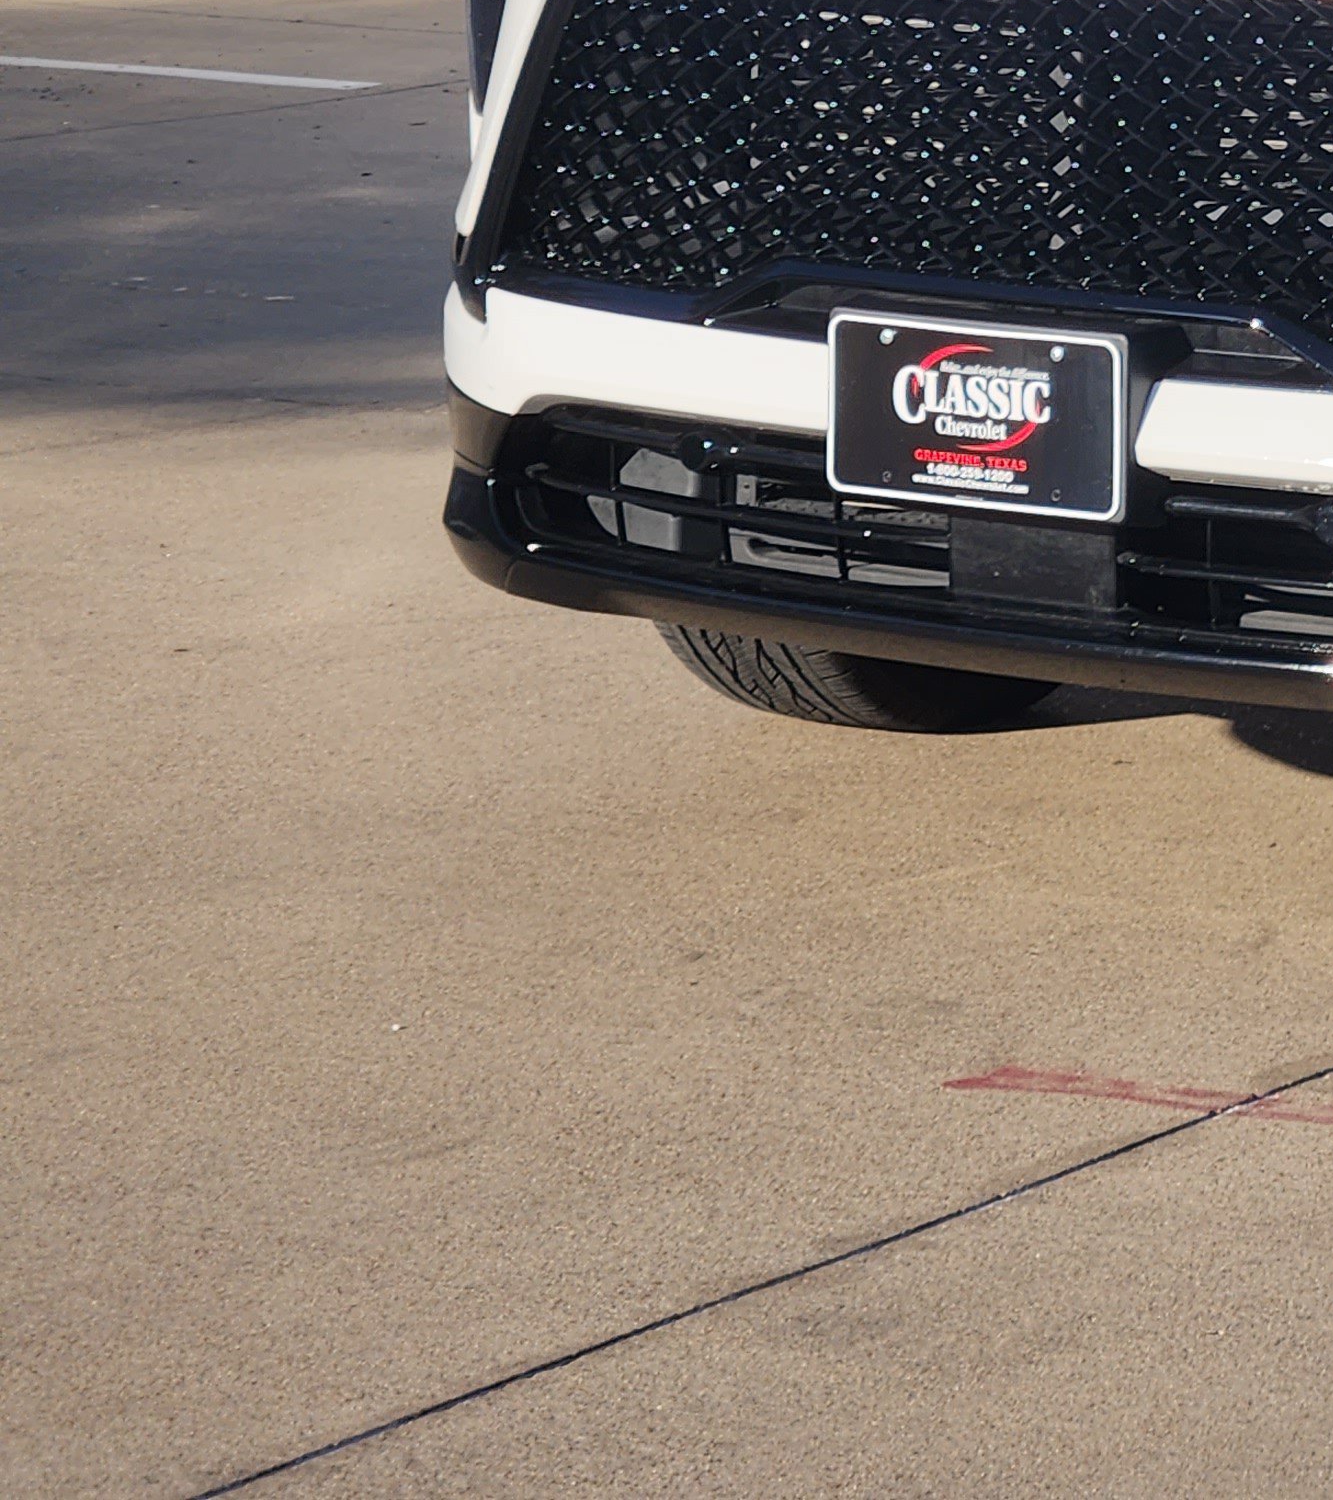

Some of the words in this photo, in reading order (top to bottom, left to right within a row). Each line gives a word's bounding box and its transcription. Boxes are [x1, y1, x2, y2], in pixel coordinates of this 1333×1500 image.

[892, 364, 1051, 424] CLASSIC
[934, 415, 1008, 441] Chevrolet
[914, 448, 985, 468] GRAPEVINE,
[985, 456, 1028, 472] TEXAS
